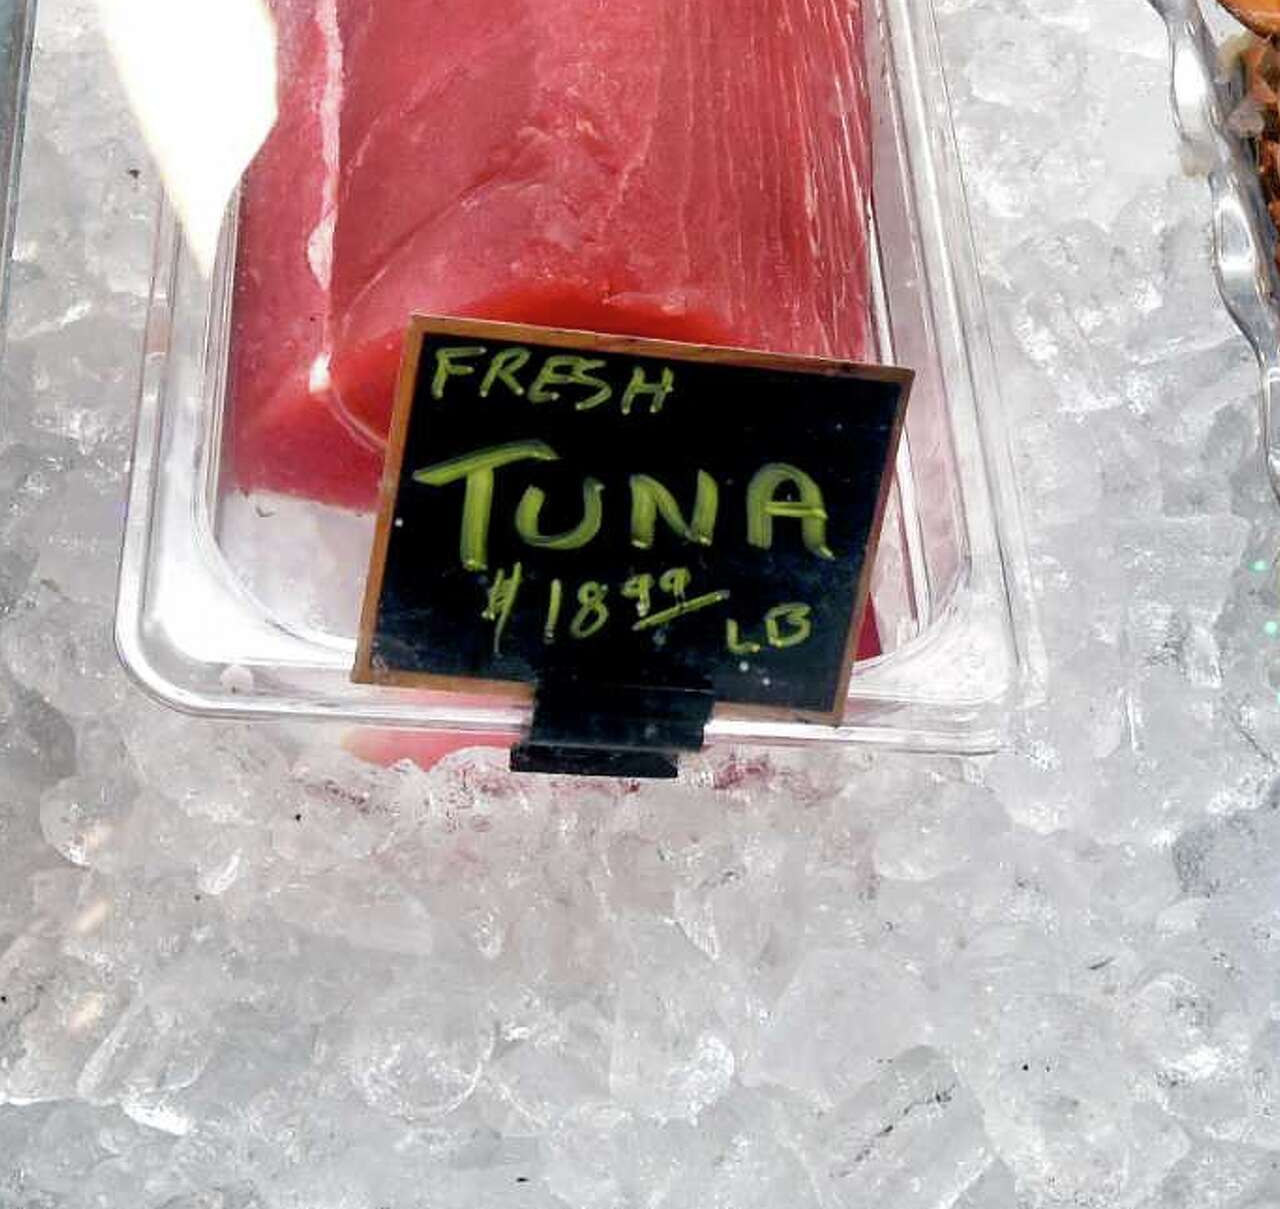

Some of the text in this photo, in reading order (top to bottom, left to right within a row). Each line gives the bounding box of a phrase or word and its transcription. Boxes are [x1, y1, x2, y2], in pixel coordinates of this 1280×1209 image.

[431, 345, 675, 414] FRESH
[412, 439, 836, 572] TUNA
[726, 602, 812, 654] LB
